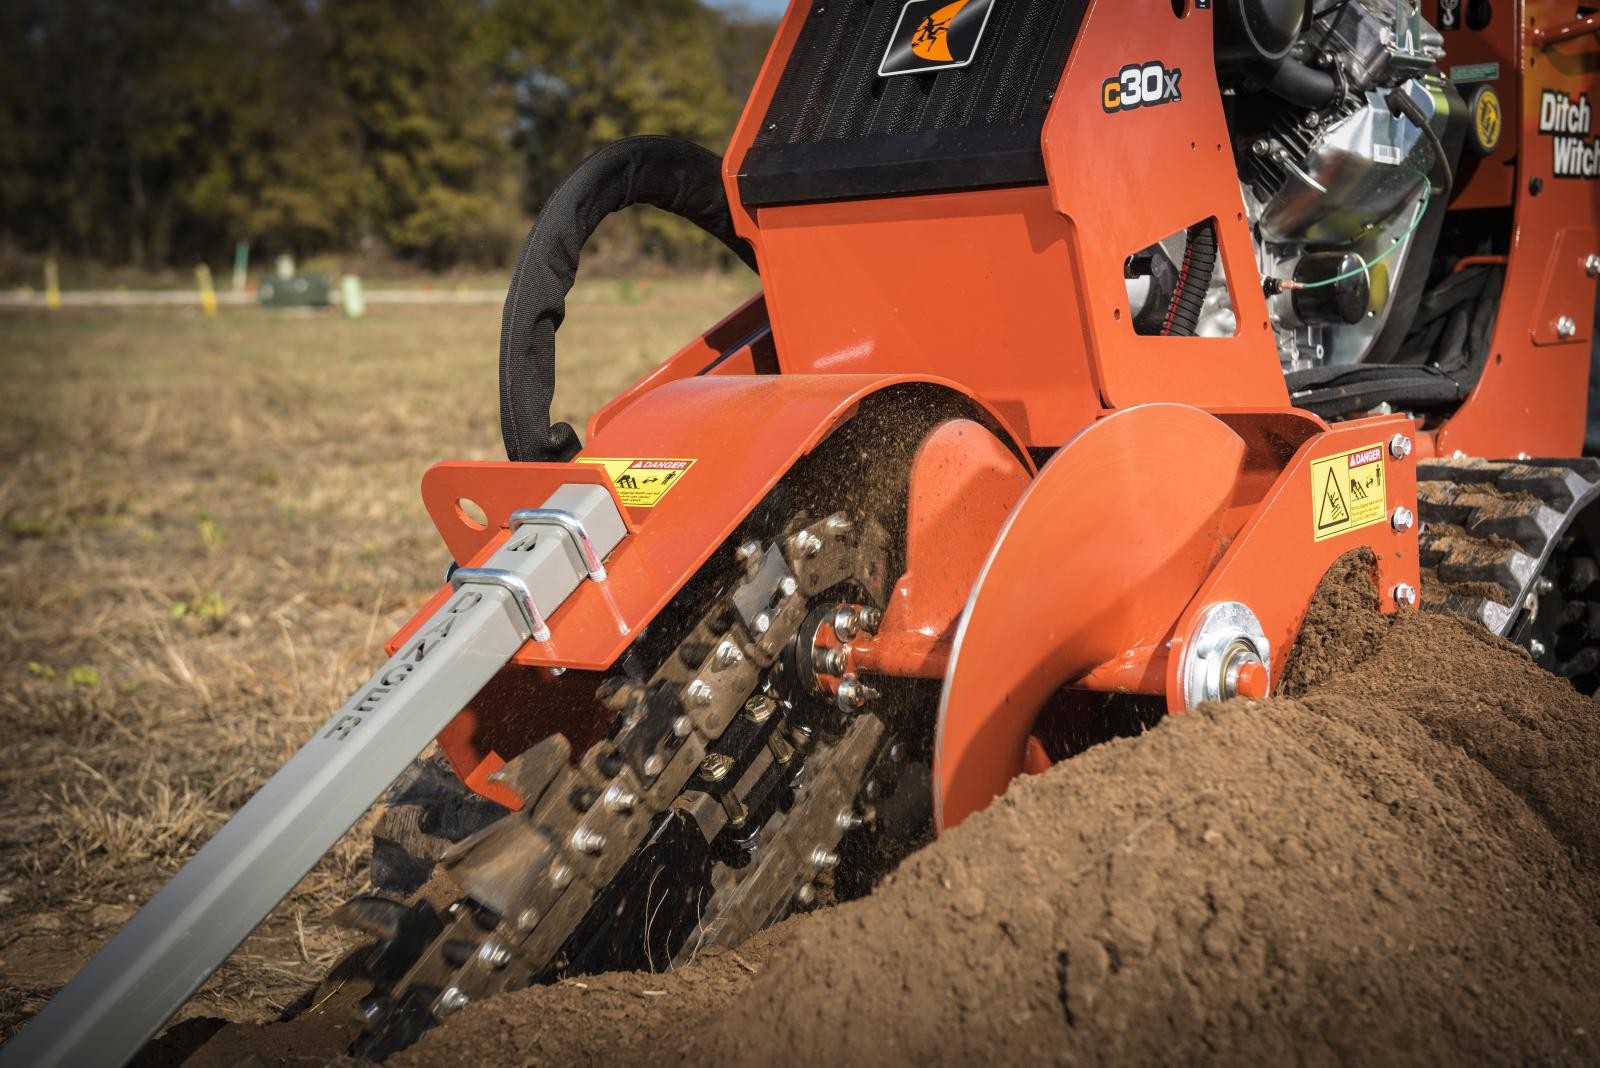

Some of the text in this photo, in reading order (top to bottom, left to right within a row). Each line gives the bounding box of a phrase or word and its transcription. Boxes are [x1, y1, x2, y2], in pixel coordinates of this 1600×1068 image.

[1540, 92, 1591, 133] Ditch
[642, 461, 687, 469] DANGER
[1355, 449, 1381, 465] DANGER
[323, 592, 483, 740] DANGER
